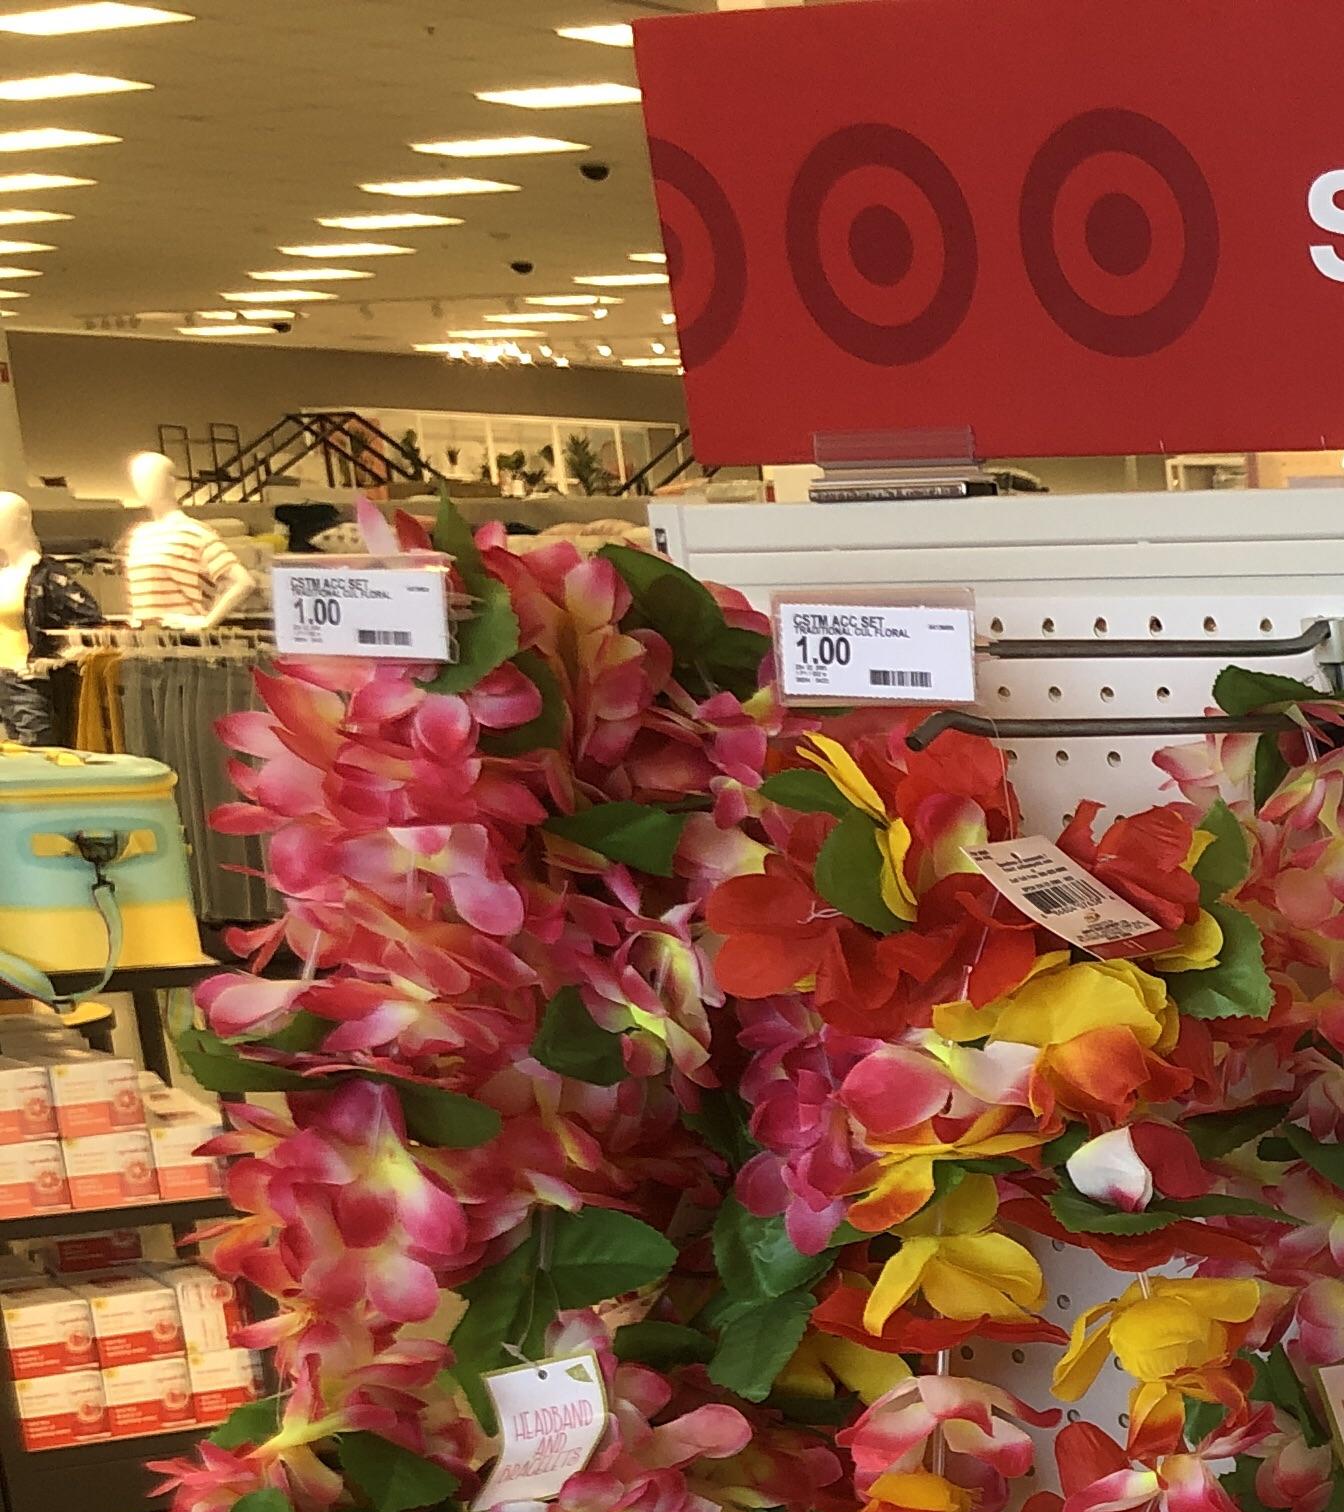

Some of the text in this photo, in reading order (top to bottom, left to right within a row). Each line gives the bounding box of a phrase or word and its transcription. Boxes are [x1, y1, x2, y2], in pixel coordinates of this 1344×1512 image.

[323, 578, 345, 589] ACC
[348, 578, 369, 590] SET
[294, 598, 341, 625] 1.00
[793, 613, 885, 629] CSTM ACC SET
[875, 628, 910, 639] FLORAL
[796, 636, 851, 666] 1.00
[513, 1399, 594, 1441] HEADBAND
[536, 1432, 568, 1455] AND
